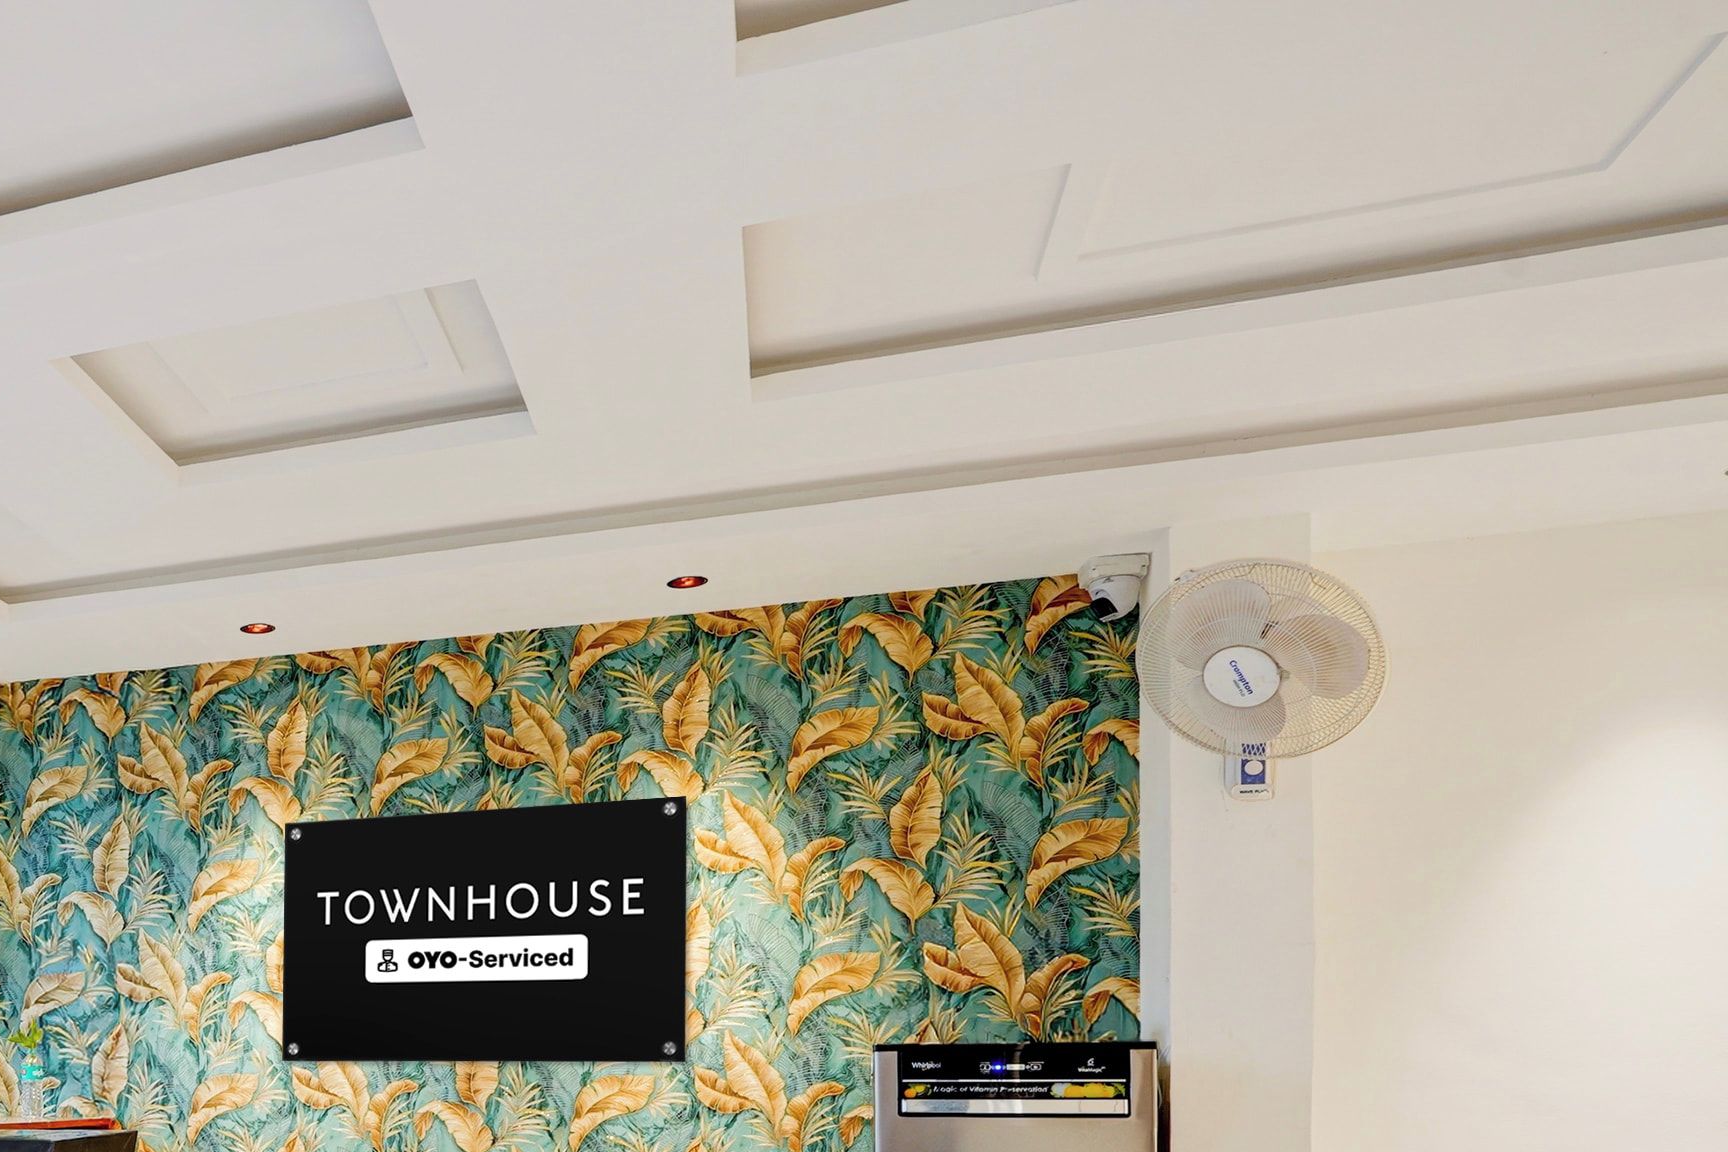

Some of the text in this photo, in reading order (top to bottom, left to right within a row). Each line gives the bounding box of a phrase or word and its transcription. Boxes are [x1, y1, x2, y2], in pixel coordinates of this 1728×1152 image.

[1229, 660, 1254, 695] Crompton
[317, 877, 645, 926] TOWNHOUSE
[407, 947, 574, 970] OYO-Serviced
